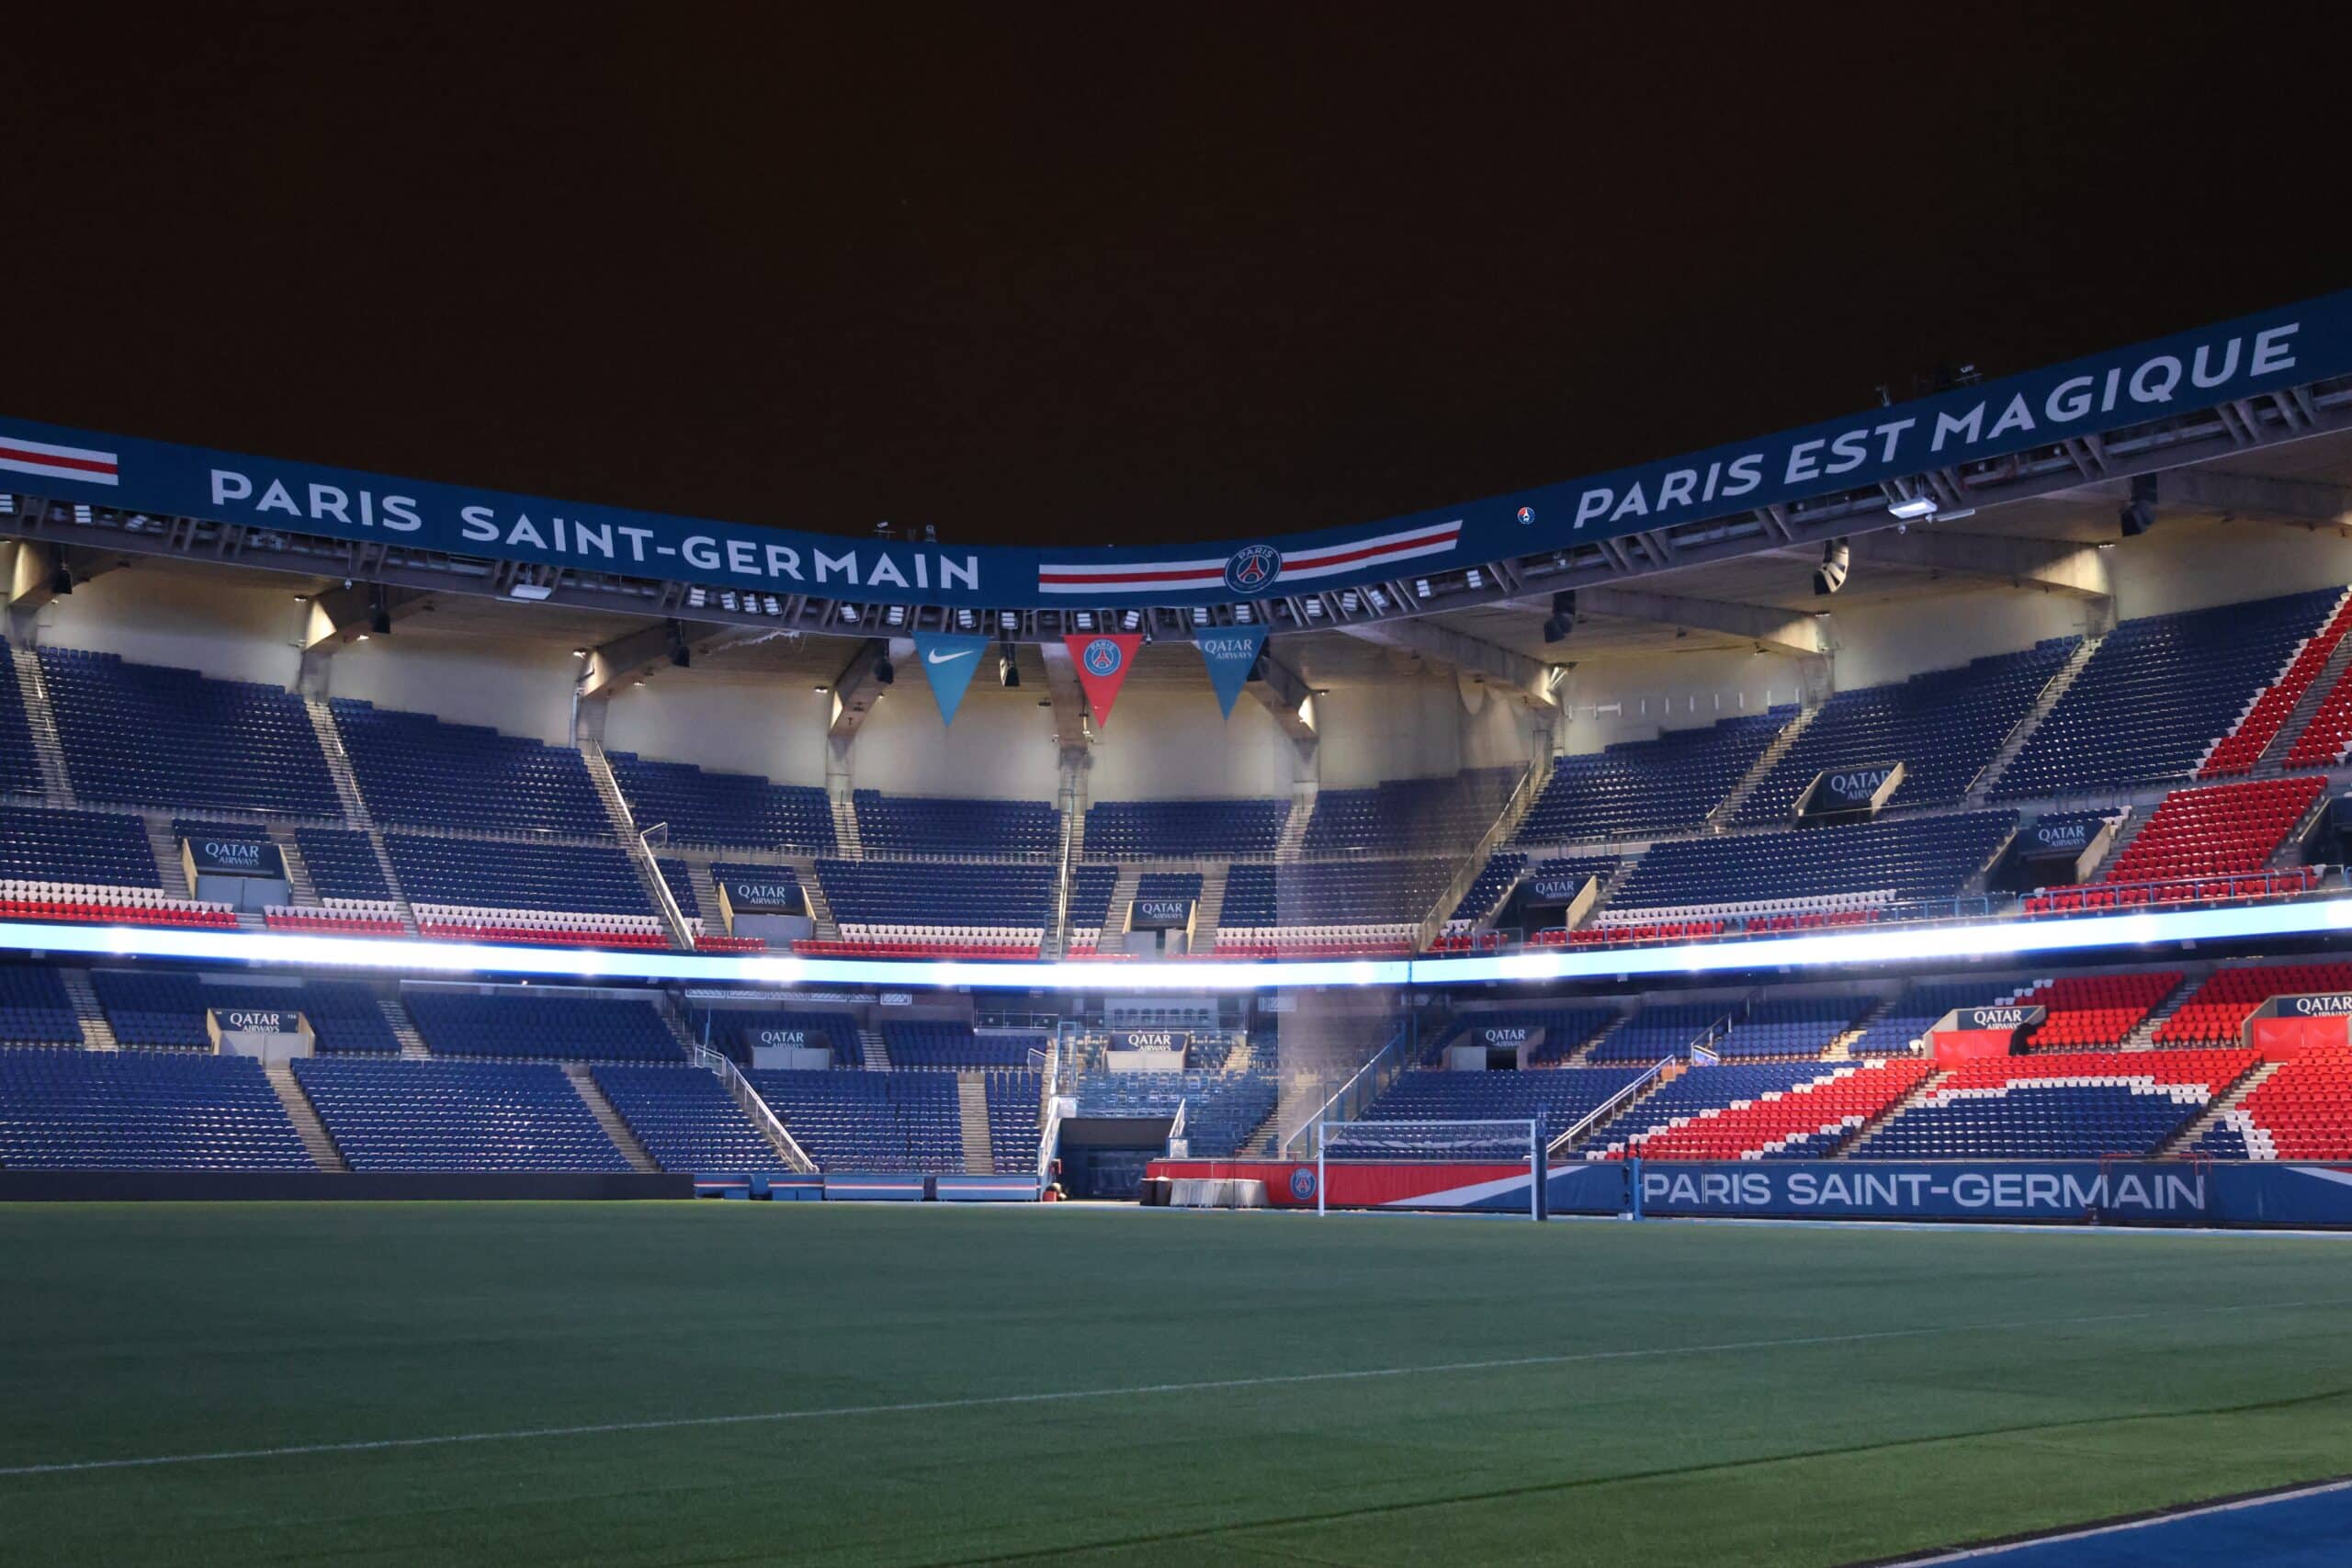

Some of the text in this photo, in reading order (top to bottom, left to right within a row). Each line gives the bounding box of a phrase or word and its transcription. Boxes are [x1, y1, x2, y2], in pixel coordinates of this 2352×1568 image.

[1573, 322, 2300, 529] PARIS EST MAGIQUE
[210, 469, 979, 591] PARIS SAINT-GERMAIN
[1237, 547, 1273, 559] PARIS
[1204, 638, 1252, 654] QATAR
[1216, 651, 1252, 660] AIRWAYS
[2038, 825, 2085, 843] QATAR
[205, 842, 259, 858] QATAR
[219, 856, 259, 866] AIRWAYS
[738, 885, 786, 898] QATAR
[1535, 880, 1574, 895] QATAR
[750, 897, 786, 905] AIRWAYS
[1142, 903, 1182, 915] QATAR
[2296, 996, 2352, 1014] QATAR
[230, 1012, 279, 1027] QATAR
[1973, 1010, 2022, 1026] QATAR
[761, 1031, 804, 1043] QATAR
[1128, 1034, 1171, 1047] QATAR
[1485, 1029, 1526, 1043] QATAR
[1644, 1173, 2205, 1209] PARIS SAINT-GERMAIN
